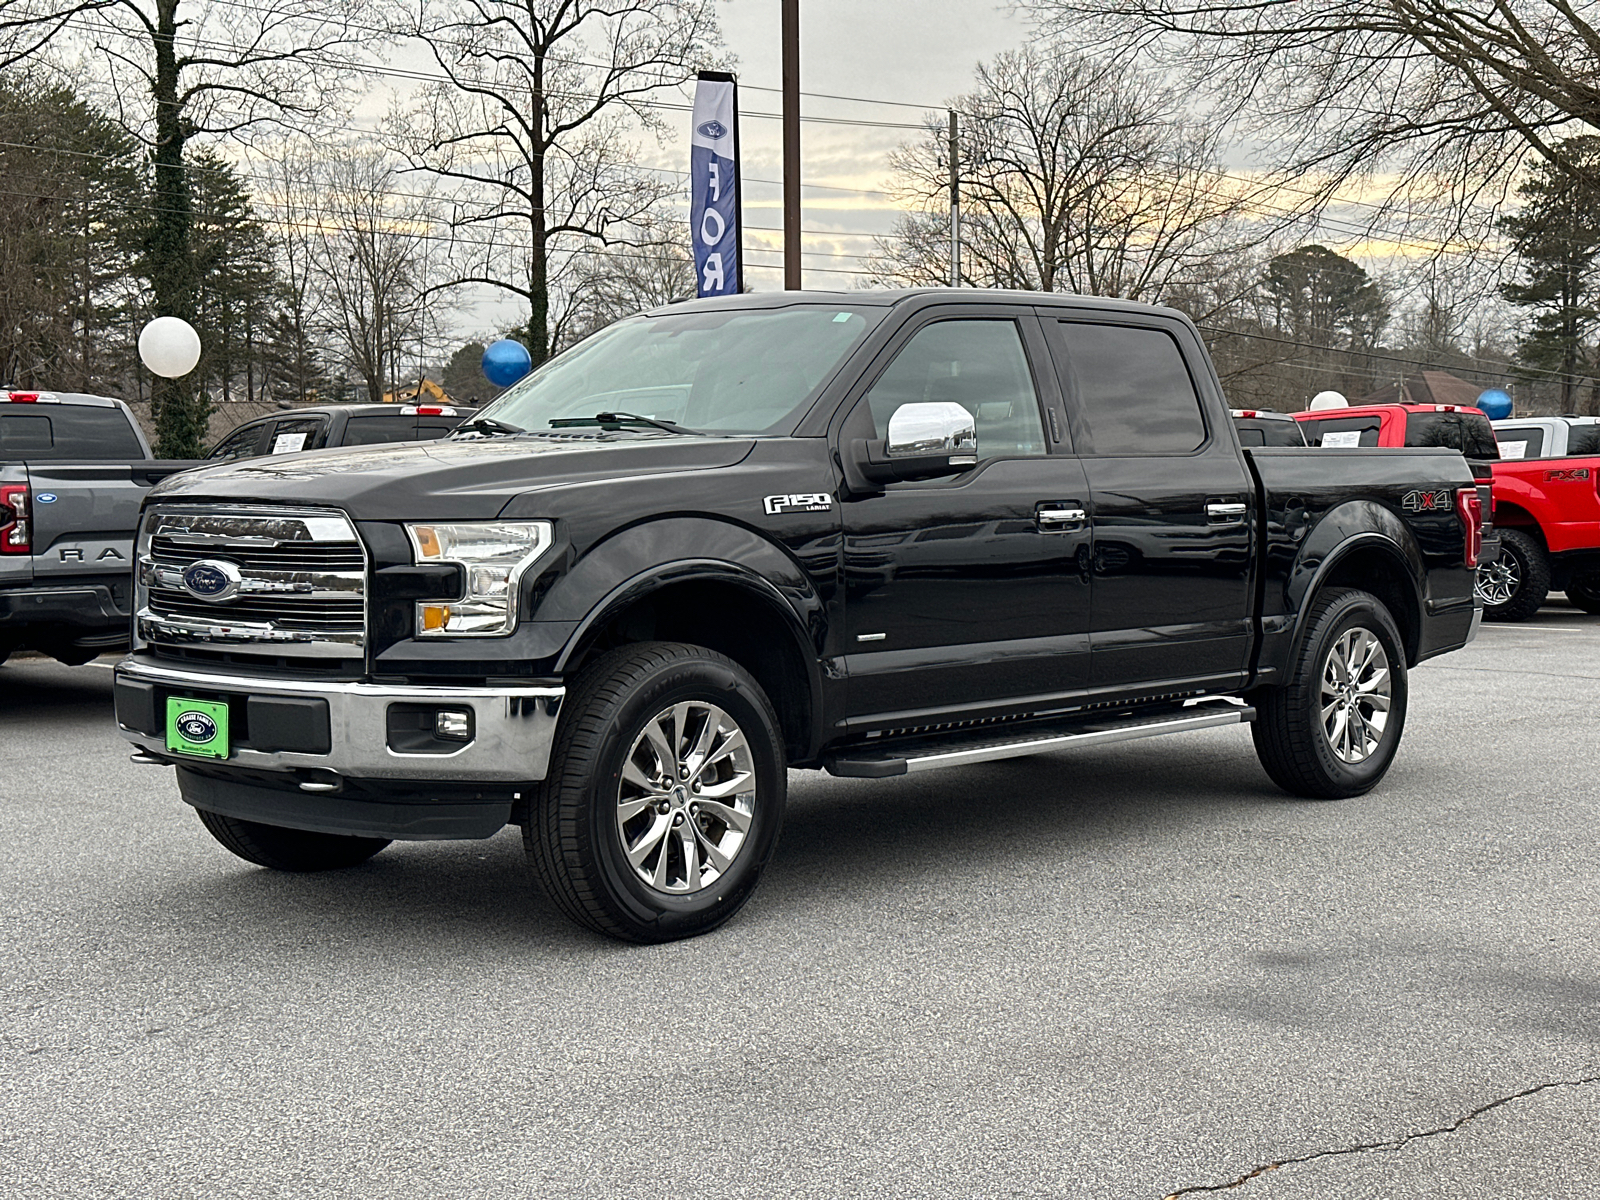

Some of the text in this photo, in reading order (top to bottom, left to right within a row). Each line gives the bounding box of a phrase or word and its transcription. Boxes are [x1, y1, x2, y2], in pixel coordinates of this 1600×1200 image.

[1542, 468, 1590, 482] FX4
[190, 569, 220, 590] Ford
[197, 714, 213, 727] FAMILY
